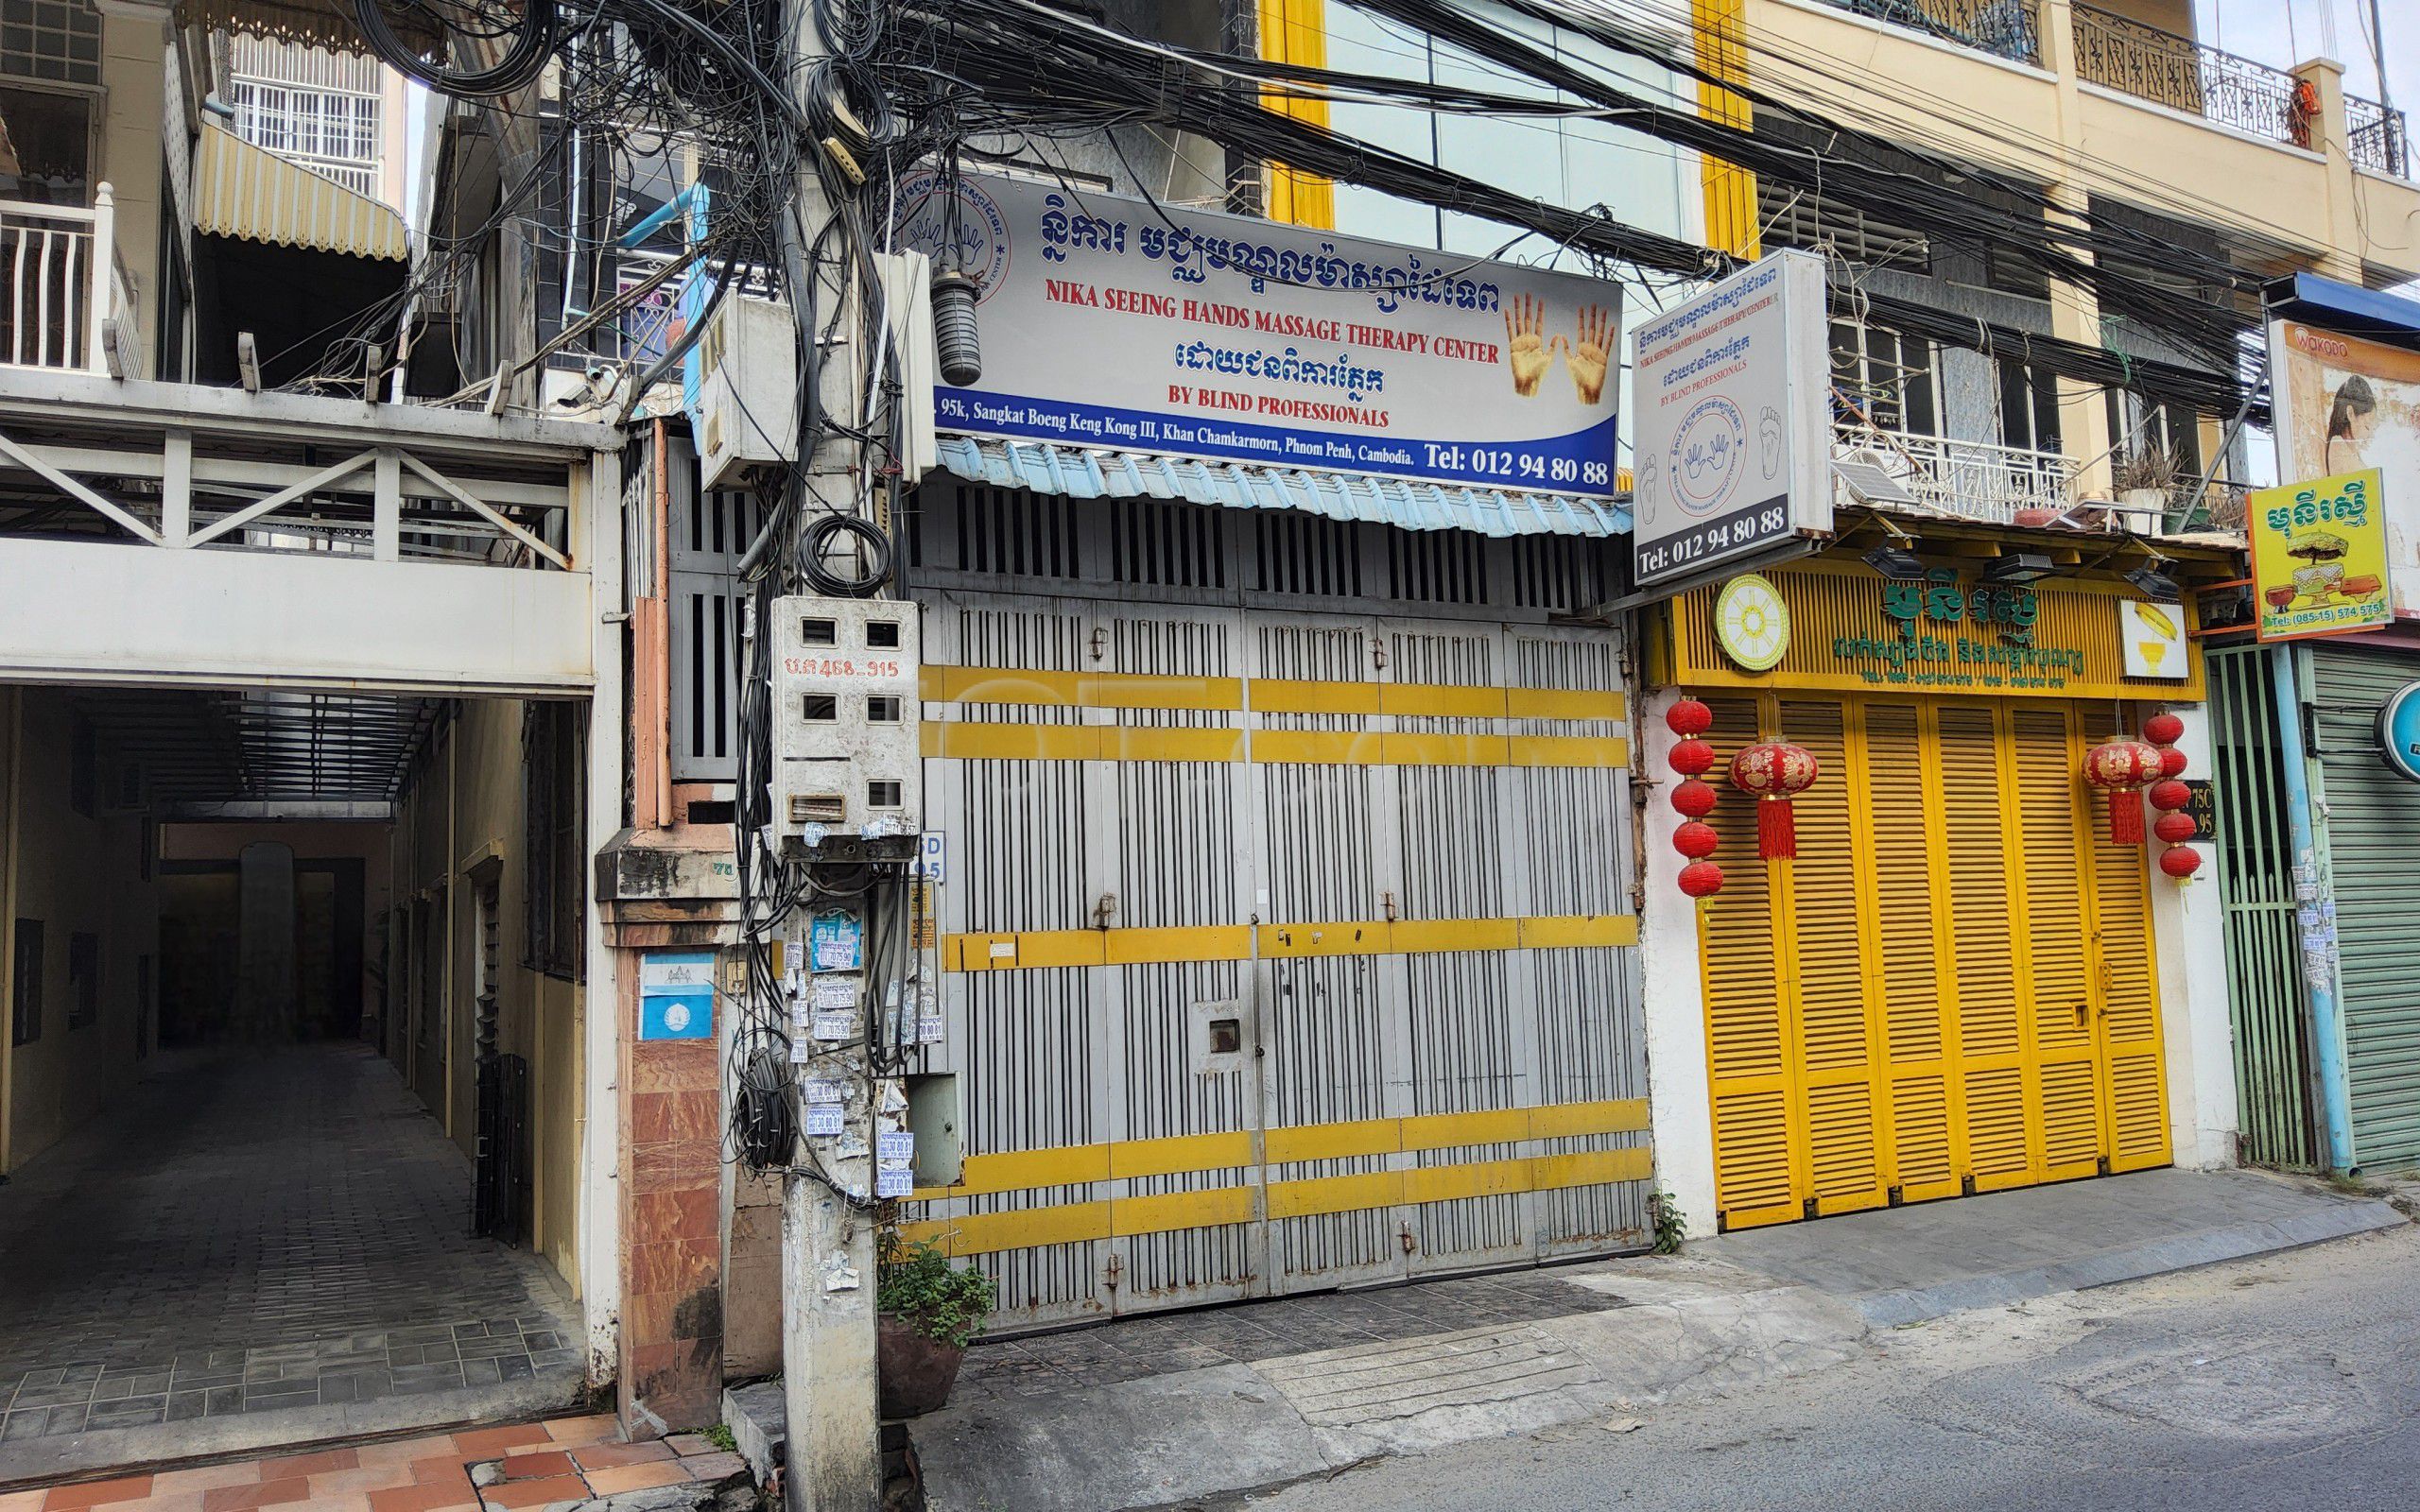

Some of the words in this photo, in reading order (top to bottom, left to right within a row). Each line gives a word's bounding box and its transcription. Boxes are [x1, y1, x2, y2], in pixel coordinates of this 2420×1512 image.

[1046, 279, 1098, 307] NIKA
[1105, 287, 1176, 318] SEEING
[1184, 300, 1250, 329] HANDS
[1255, 309, 1340, 343] MASSAGE
[1346, 323, 1428, 354] THERAPY
[1434, 336, 1498, 365] CENTER
[1640, 355, 1654, 369] NIKA
[1660, 391, 1670, 407] BY
[1670, 383, 1691, 404] BLIND
[1692, 359, 1748, 394] PROFESSIONALS
[1167, 385, 1193, 404] BY
[1199, 388, 1253, 412] BLIND
[1258, 396, 1390, 428] PROFESSIONALS
[942, 398, 970, 421] 95k,
[974, 402, 1025, 425] Sangkat
[1028, 408, 1066, 432] Boeng
[1069, 413, 1101, 436] Keng
[1105, 417, 1137, 439] Kong
[1140, 421, 1160, 441] III,
[1163, 422, 1194, 442] Khan
[1198, 427, 1282, 455] Chamkarmorn,
[1286, 437, 1322, 455] Phnom
[1326, 441, 1356, 463] Penh,
[1358, 445, 1414, 466] Cambodia.
[1425, 444, 1466, 472] Tel:
[1473, 449, 1512, 478] 012
[1519, 454, 1546, 482] 94
[1550, 457, 1578, 484] 80
[1582, 462, 1609, 487] 88
[1639, 549, 1669, 574] Tel:
[1672, 534, 1703, 564] 012
[1707, 524, 1730, 552] 94
[1734, 515, 1756, 542] 80
[1760, 506, 1785, 534] 88
[2271, 616, 2290, 627] Tel:
[2292, 610, 2335, 626] (085-15)
[2337, 607, 2358, 619] 574
[2360, 603, 2381, 616] 575
[2192, 788, 2212, 809] 75C
[2199, 813, 2212, 833] 95
